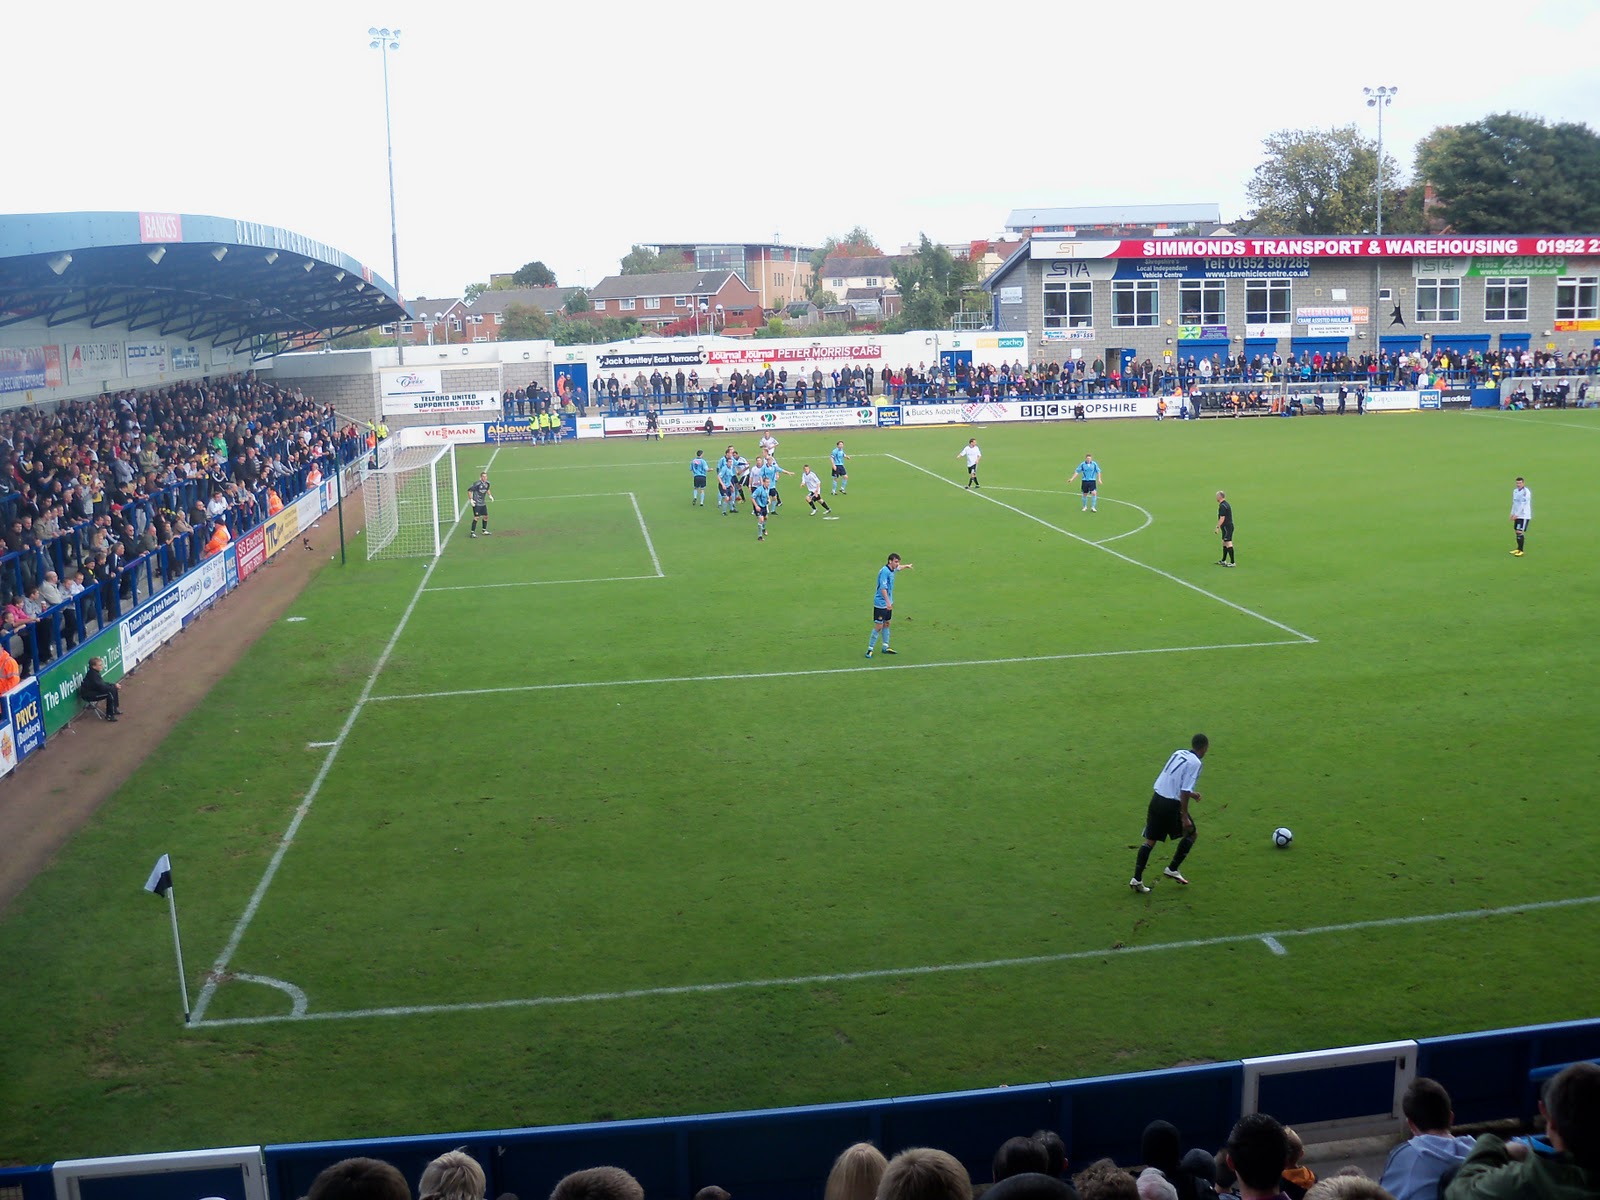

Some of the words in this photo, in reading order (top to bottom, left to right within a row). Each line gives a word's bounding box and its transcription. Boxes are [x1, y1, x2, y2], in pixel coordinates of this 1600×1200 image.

[1142, 240, 1246, 256] SIMMONDS
[1251, 240, 1363, 255] TRANSPORT
[1368, 240, 1381, 254] &
[1385, 240, 1518, 254] WAREHOUSING
[1536, 239, 1585, 254] 01952
[1588, 239, 1600, 252] 2
[1204, 258, 1224, 269] Tel:
[1228, 258, 1264, 268] 01952
[1268, 257, 1310, 268] 587285
[1503, 256, 1565, 268] 236039
[1046, 260, 1090, 278] STA
[1205, 270, 1308, 278] www.stavehiclecentre.co.uk
[1000, 338, 1023, 348] peachey
[711, 350, 740, 360] Journal
[744, 350, 774, 358] Journal
[778, 348, 810, 358] PETER
[812, 347, 850, 358] MORRIS
[852, 346, 880, 356] CARS
[625, 357, 652, 366] Bentley
[1021, 404, 1058, 417] BBC
[1061, 403, 1137, 414] SHOPSHIRE
[44, 692, 59, 711] The
[60, 672, 83, 700] Wrekin
[108, 642, 121, 664] Trust
[16, 701, 38, 730] PRYCE
[1164, 752, 1188, 776] 17
